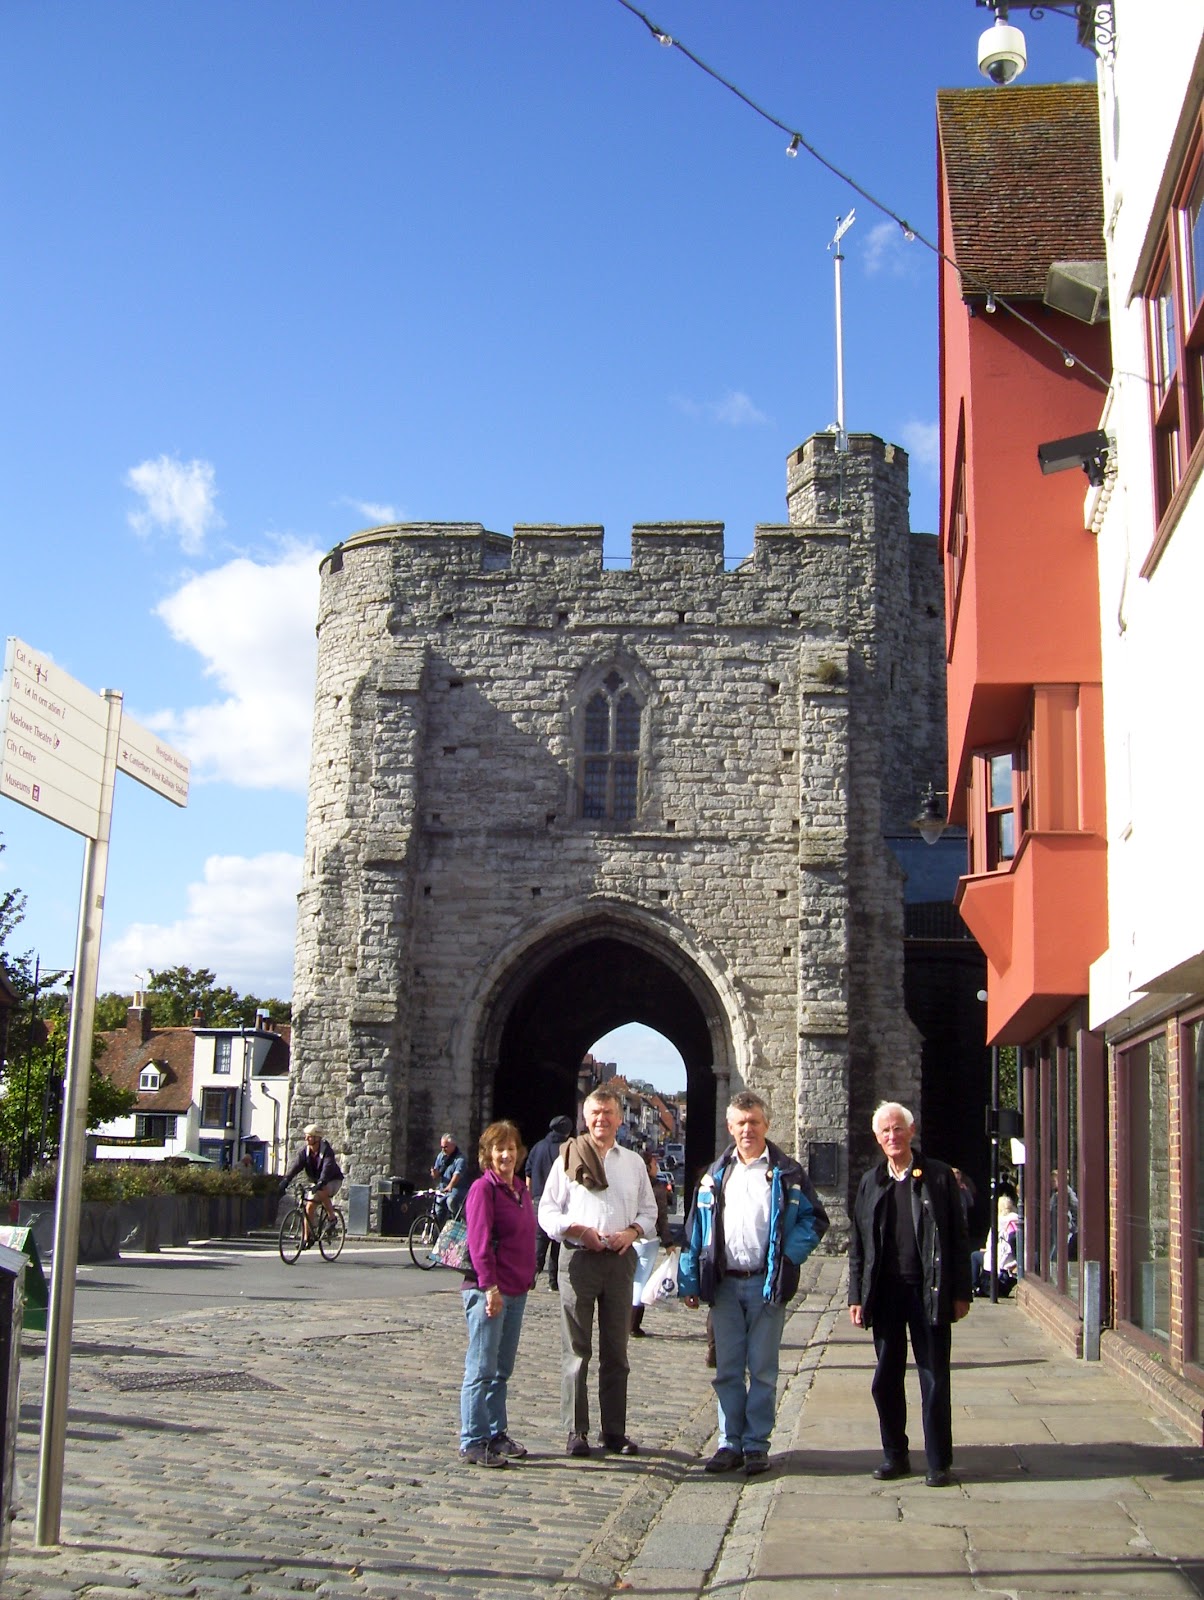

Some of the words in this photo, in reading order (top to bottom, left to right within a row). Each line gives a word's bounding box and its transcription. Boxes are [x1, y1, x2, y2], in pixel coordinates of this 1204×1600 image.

[32, 689, 61, 716] Inormation
[9, 711, 33, 733] Marlowe
[34, 725, 52, 747] Theatre
[6, 738, 17, 757] City
[18, 745, 37, 764] Centre
[5, 772, 31, 795] Museums
